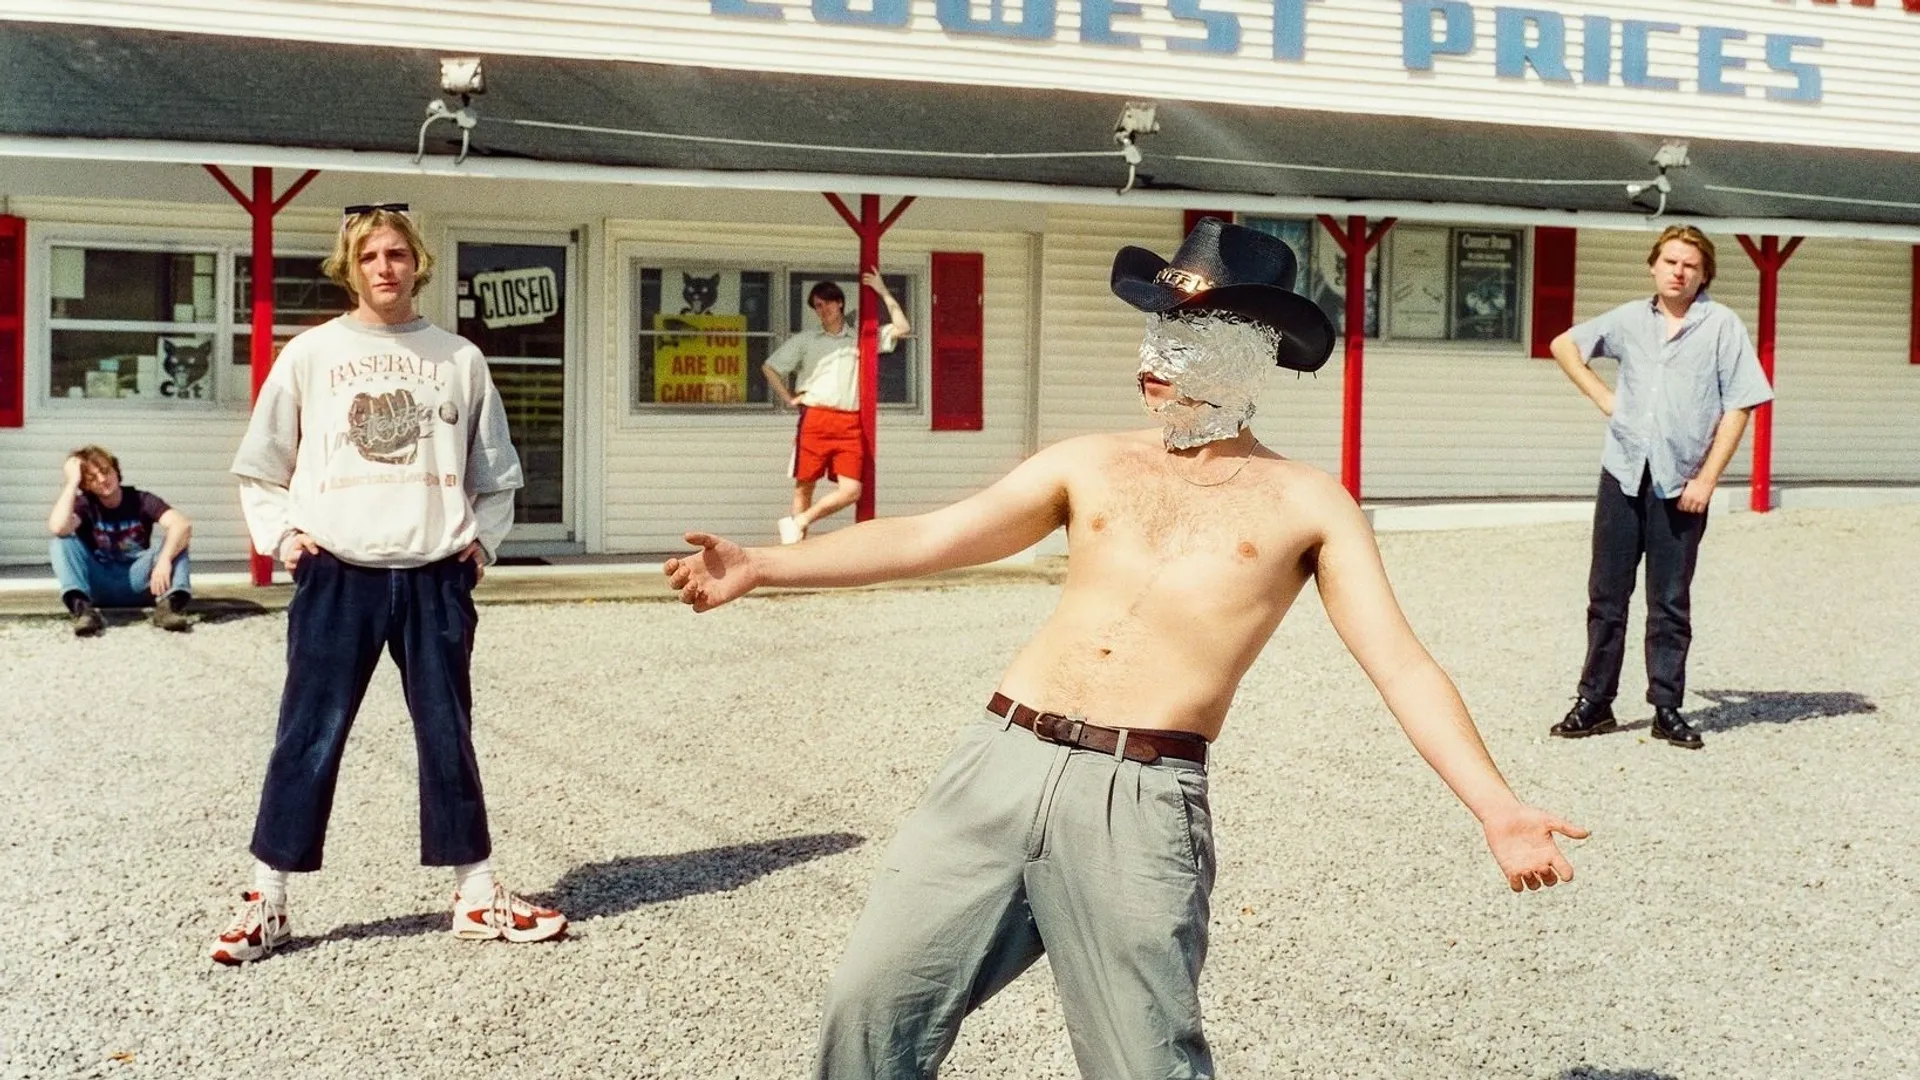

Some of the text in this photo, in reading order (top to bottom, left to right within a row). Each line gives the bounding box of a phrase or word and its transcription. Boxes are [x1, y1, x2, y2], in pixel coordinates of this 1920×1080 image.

[710, 0, 1823, 101] WEST PRICES
[480, 276, 553, 319] CLOSED
[704, 327, 740, 348] YOU
[329, 354, 445, 388] BASEBALL
[672, 355, 740, 376] ARE ON
[660, 383, 741, 402] CAMERA
